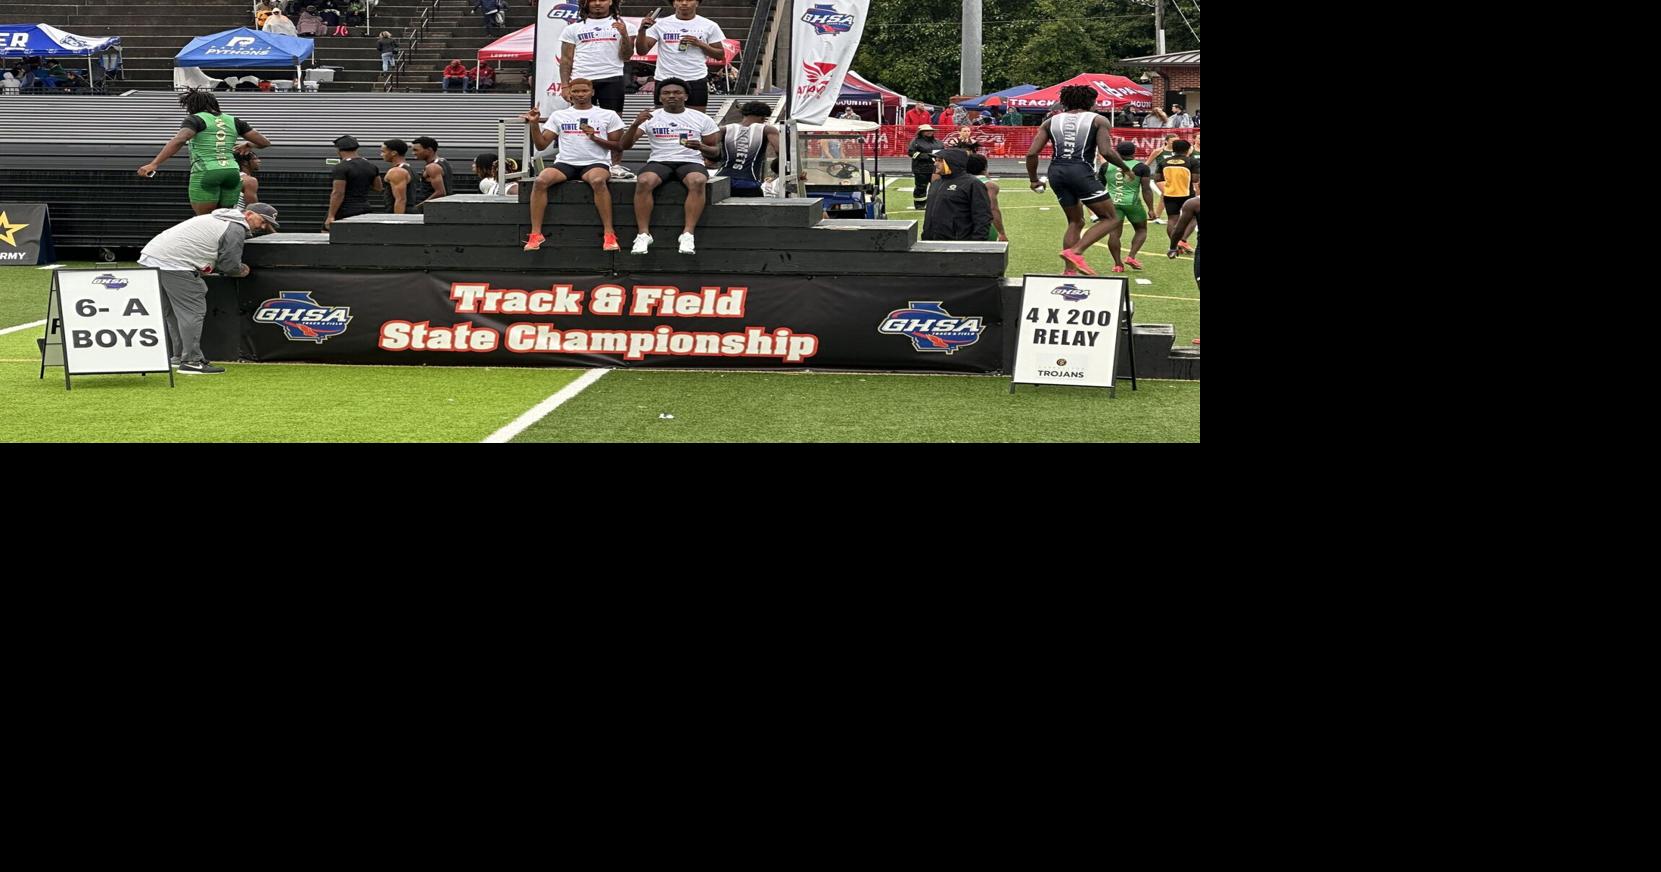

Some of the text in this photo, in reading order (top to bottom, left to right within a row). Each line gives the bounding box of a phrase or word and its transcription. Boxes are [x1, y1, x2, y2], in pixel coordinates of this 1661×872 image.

[803, 13, 854, 25] GHSA
[0, 252, 26, 260] RMY
[122, 298, 150, 316] A
[451, 283, 748, 317] Track & Field
[256, 308, 347, 322] GHSA
[1026, 308, 1111, 326] 4 X 200
[881, 319, 979, 332] GHSA
[72, 328, 159, 348] BOYS
[379, 320, 818, 363] State Championship
[1033, 328, 1100, 347] RELAY
[1038, 369, 1084, 378] TROJANS
